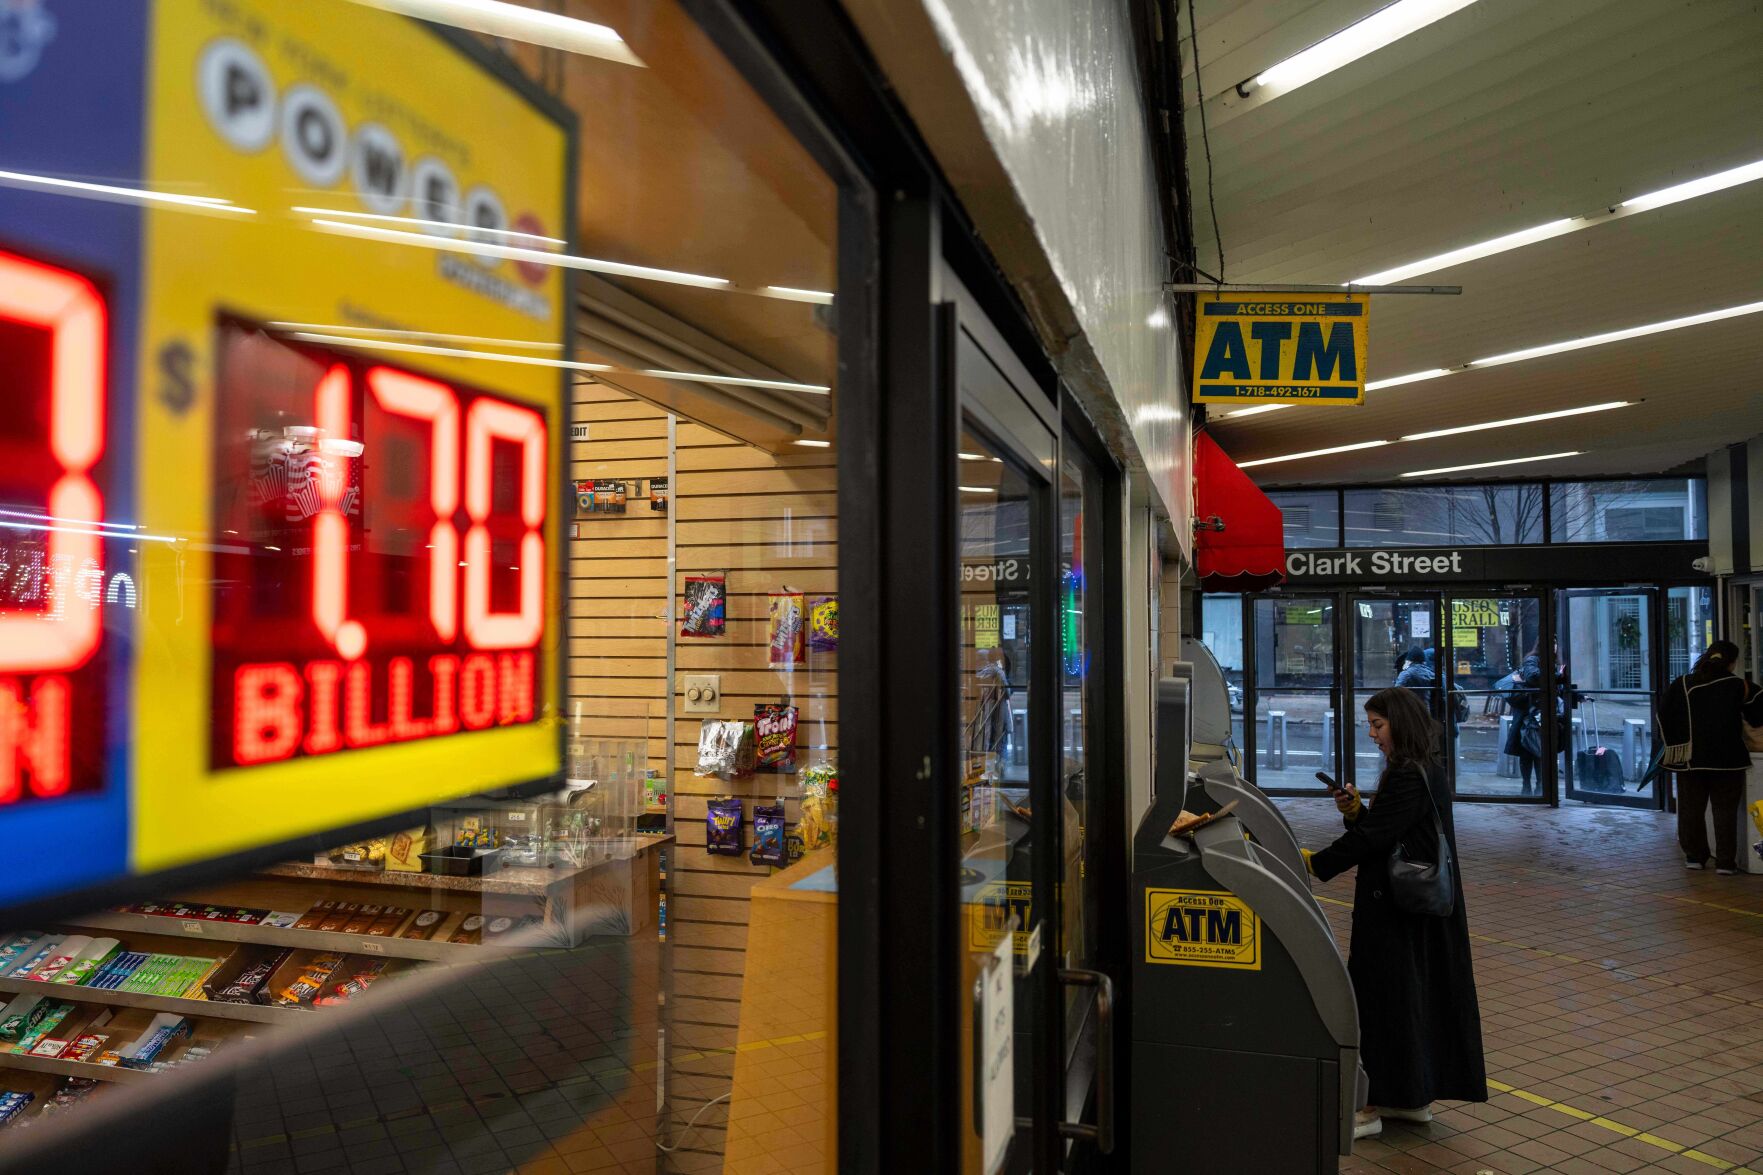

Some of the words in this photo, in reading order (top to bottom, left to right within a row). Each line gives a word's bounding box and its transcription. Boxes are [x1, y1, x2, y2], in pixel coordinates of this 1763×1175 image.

[1236, 304, 1289, 315] ACCESS
[1293, 304, 1326, 315] ONE
[1200, 321, 1358, 381] ATM
[1235, 386, 1321, 397] 1-718-492-1671
[313, 361, 547, 660] 1.70
[1286, 553, 1363, 576] Clark
[1371, 552, 1462, 575] Street
[1441, 613, 1496, 626] ERALL
[233, 652, 536, 766] BILLION
[1161, 906, 1242, 945] ATM
